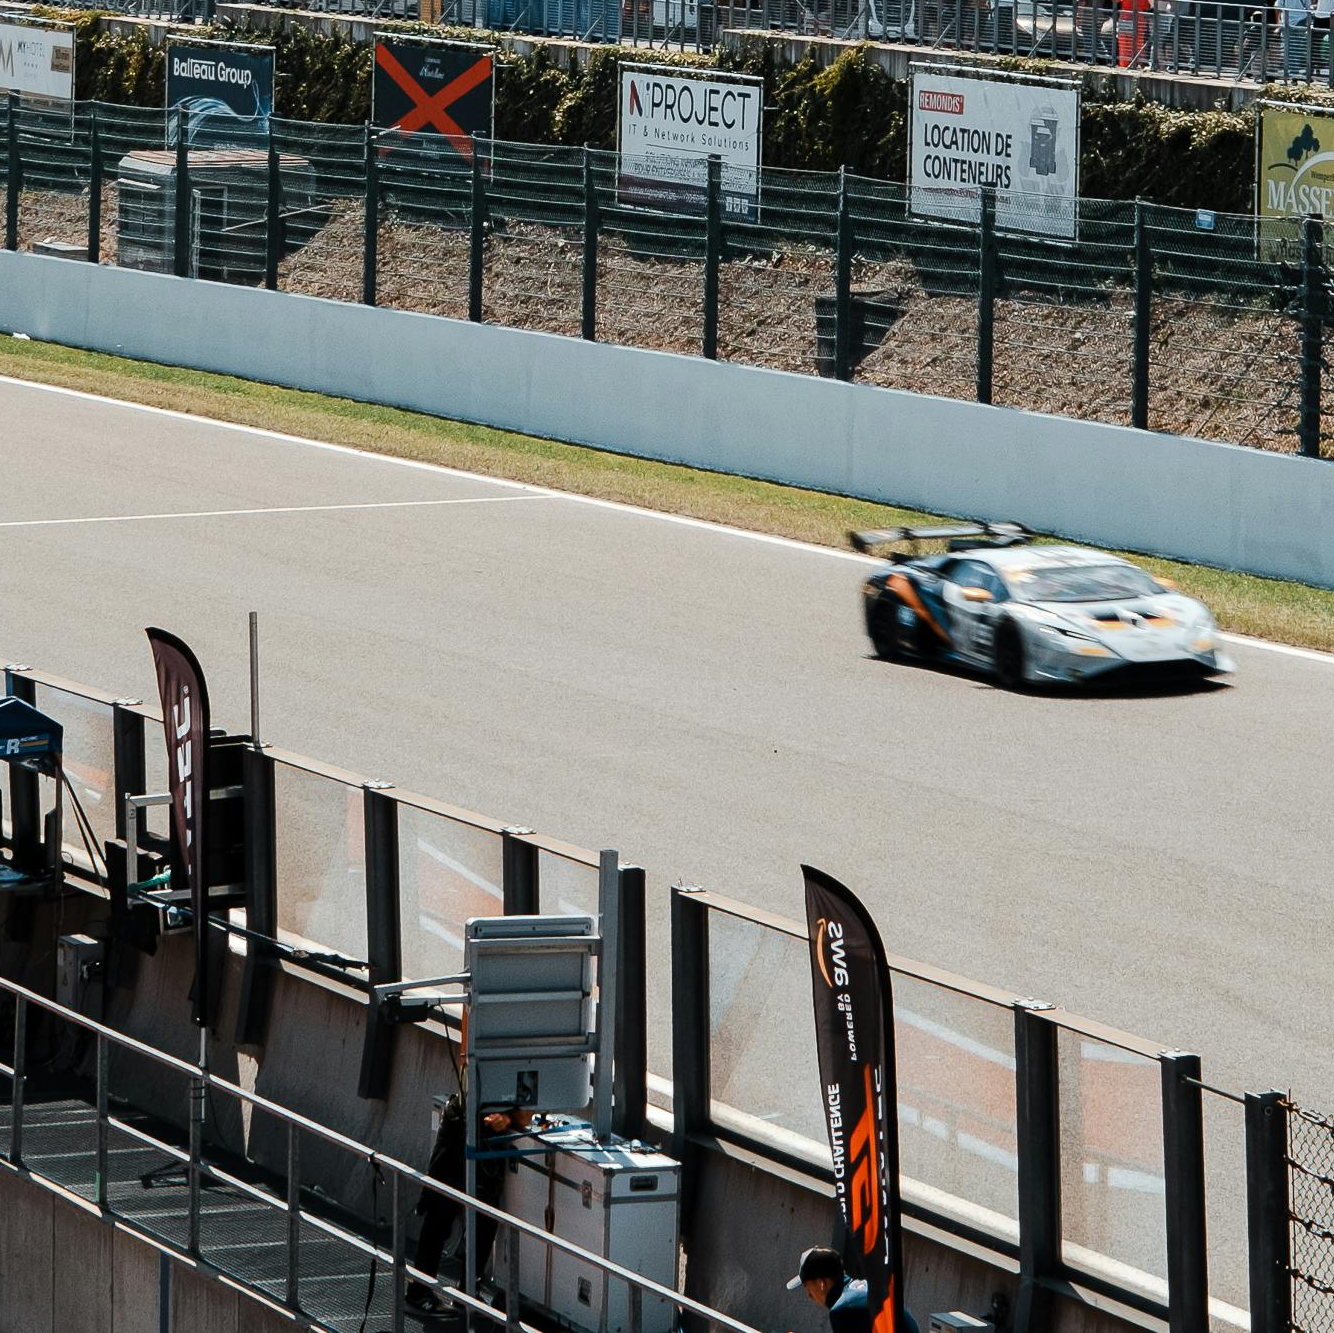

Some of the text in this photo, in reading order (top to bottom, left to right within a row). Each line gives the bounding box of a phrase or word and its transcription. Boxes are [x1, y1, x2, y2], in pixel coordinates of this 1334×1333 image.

[217, 61, 252, 90] Group
[628, 123, 750, 152] IT & Network Solutions
[924, 123, 1013, 159] LOCATION DE
[923, 153, 1012, 190] CONTENEURS
